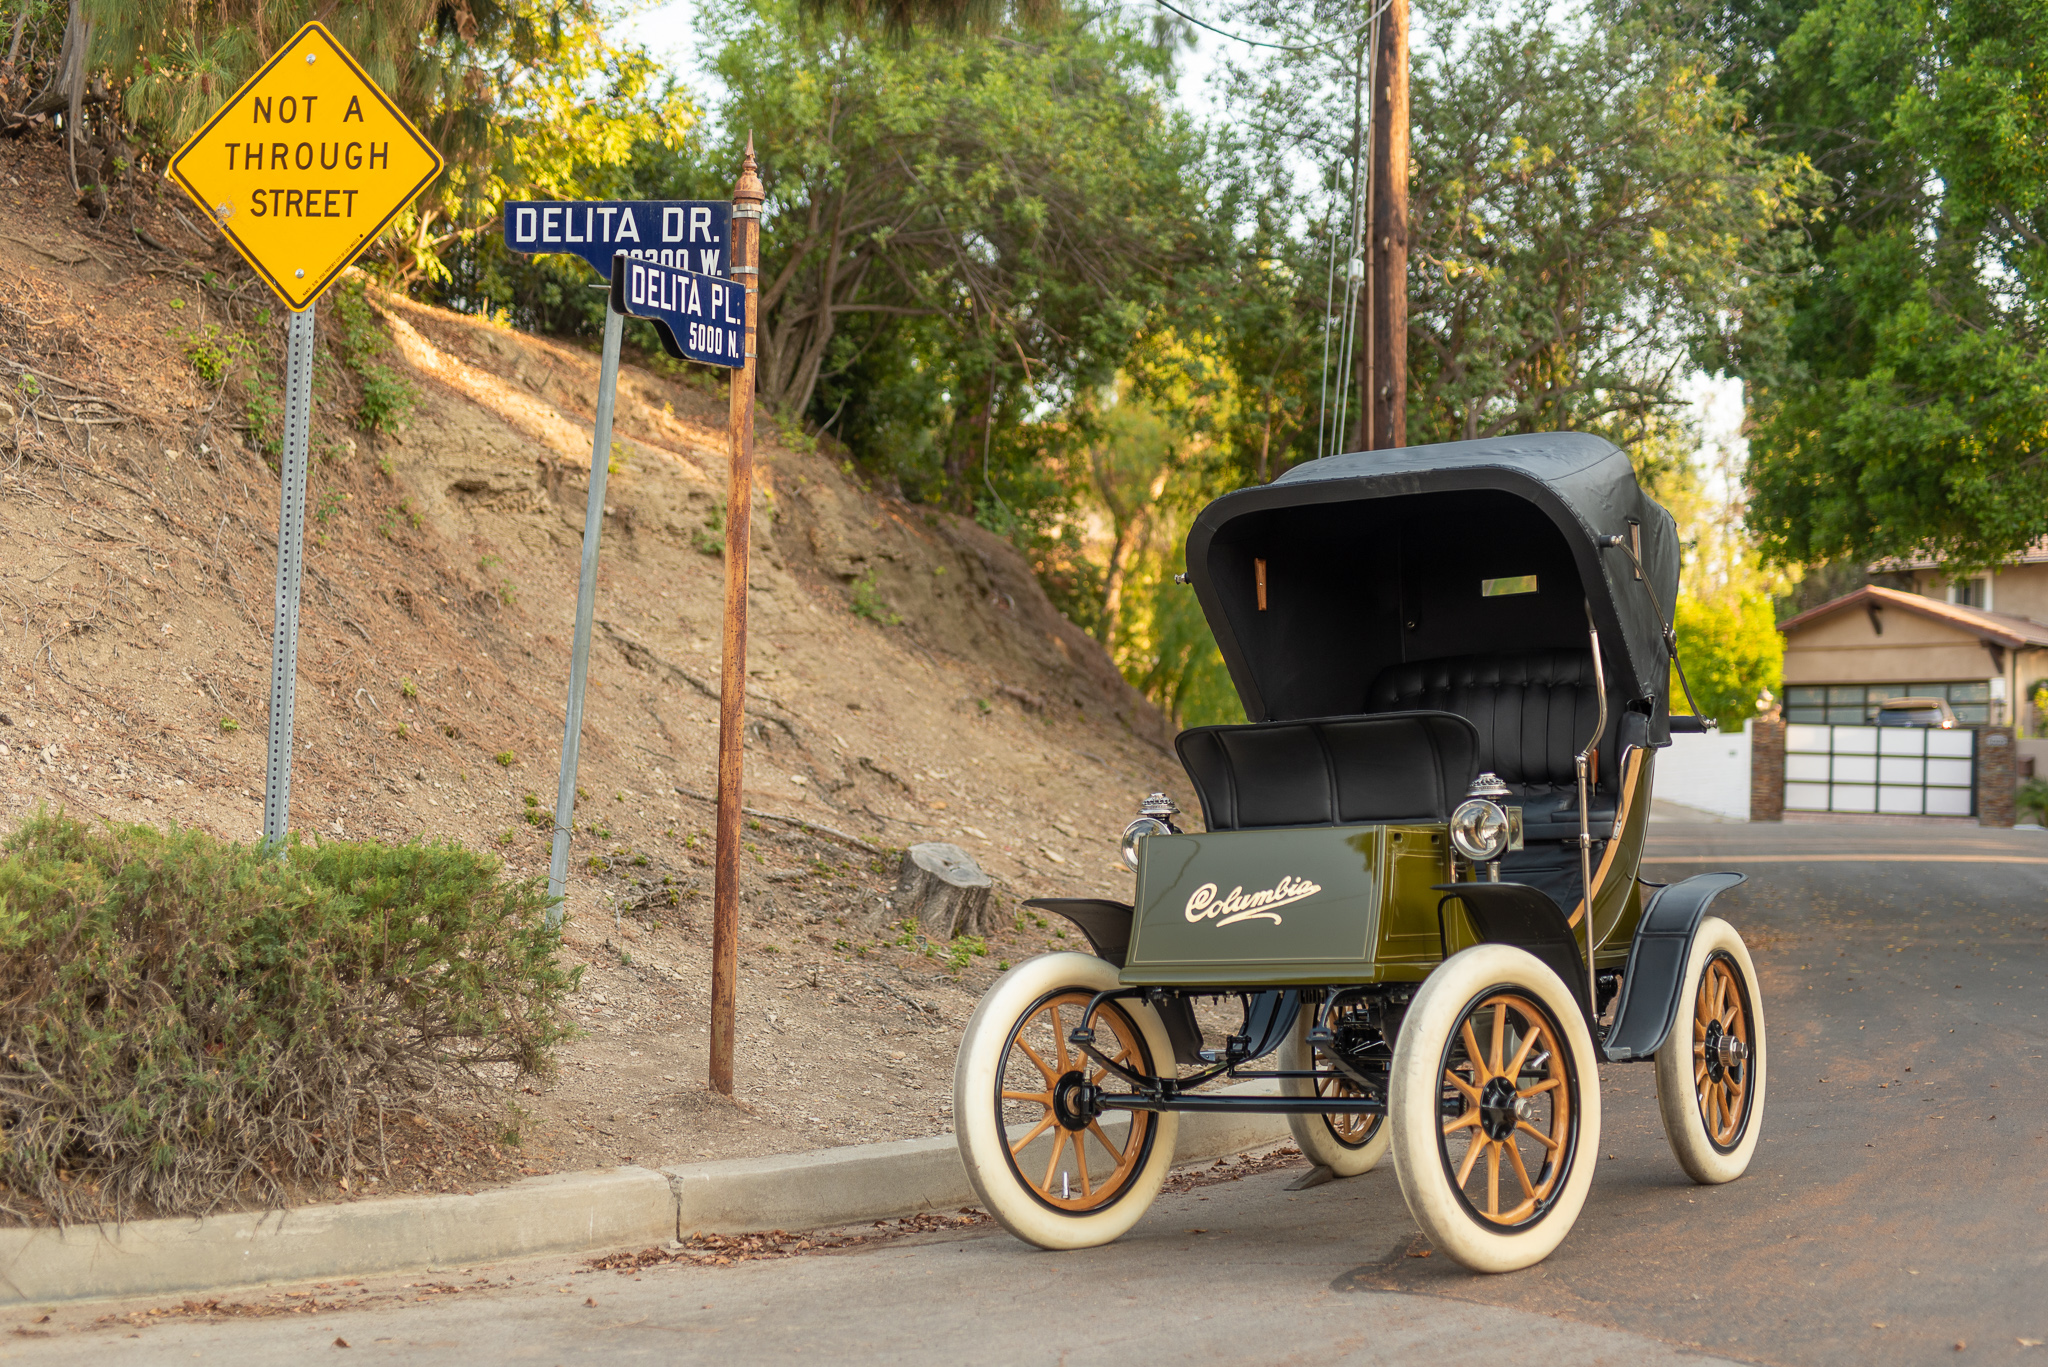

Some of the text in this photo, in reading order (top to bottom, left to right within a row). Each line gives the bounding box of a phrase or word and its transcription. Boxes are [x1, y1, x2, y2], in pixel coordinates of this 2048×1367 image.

[253, 95, 364, 124] NOT A
[224, 142, 388, 170] THROUGH
[250, 188, 358, 218] STREET
[516, 207, 720, 243] DELITA DR.
[615, 248, 722, 276] 300 W.
[631, 264, 741, 325] DELITA PL.
[689, 321, 739, 358] 5000 N.
[1185, 875, 1322, 927] Columbia
